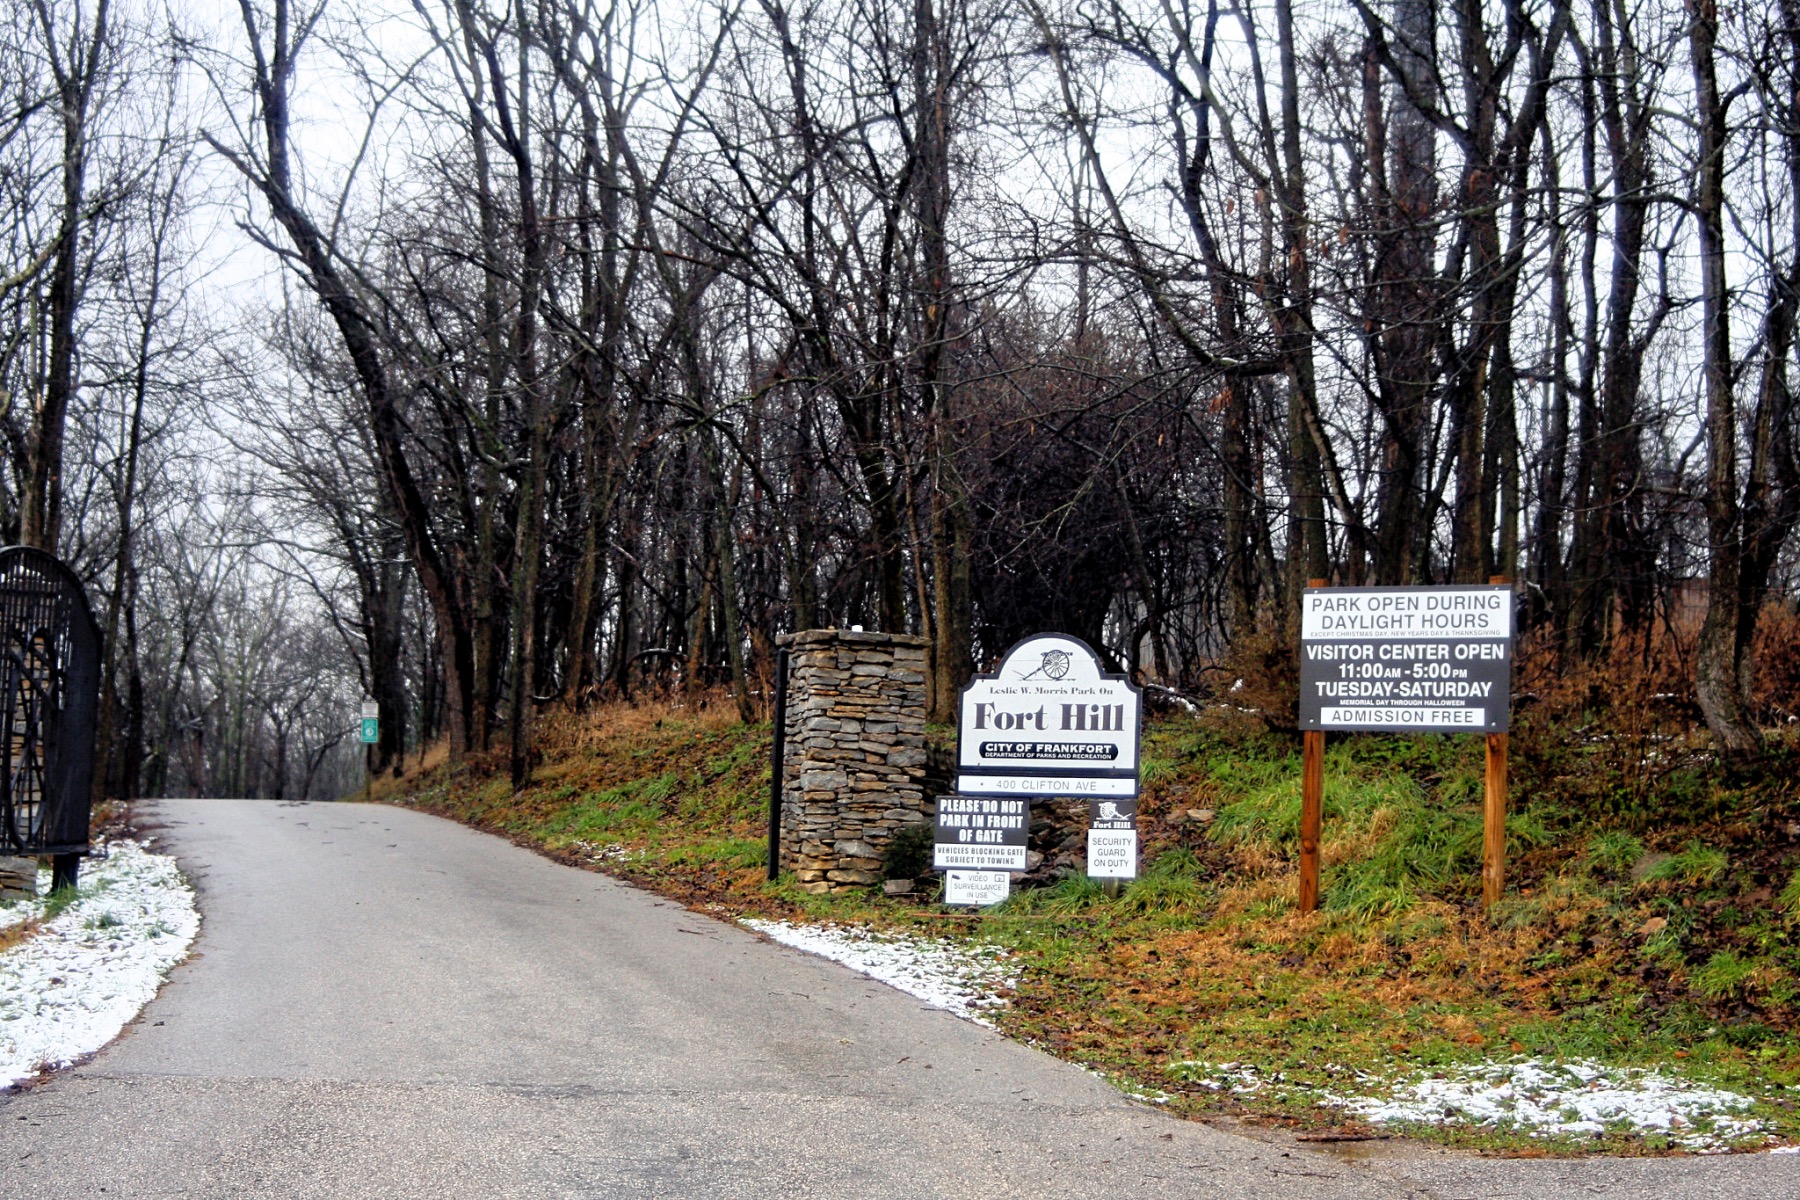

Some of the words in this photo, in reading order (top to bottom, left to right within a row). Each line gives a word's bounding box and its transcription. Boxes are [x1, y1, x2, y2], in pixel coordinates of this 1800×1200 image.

[1312, 598, 1361, 612] PARK
[1367, 596, 1419, 611] OPEN
[1427, 595, 1501, 611] DURING
[1322, 614, 1415, 630] DAYLIGHT
[1421, 613, 1489, 629] HOURS
[1306, 645, 1374, 660] VISITOR
[1379, 644, 1449, 660] CENTER
[1454, 644, 1504, 659] OPEN
[989, 687, 1018, 695] Leslie
[1021, 687, 1032, 695] W.
[1034, 687, 1068, 695] Morris
[1071, 687, 1096, 695] Park
[1099, 687, 1113, 695] On
[1315, 681, 1492, 697] TUESDAY-SATURDAY
[973, 701, 1049, 731] Fort
[1059, 703, 1125, 732] Hill
[1331, 710, 1424, 723] ADMISSION
[1431, 710, 1474, 723] FREE
[985, 743, 1013, 752] CITY
[1015, 743, 1032, 752] OF
[1036, 744, 1112, 753] FRANKFORT
[996, 780, 1016, 789] 400
[1021, 780, 1070, 791] CLIFTON
[1075, 781, 1097, 791] AVE
[939, 799, 980, 813] PLEASE
[982, 800, 997, 814] DO
[1001, 801, 1024, 814] NOT
[939, 814, 969, 827] PARK
[972, 814, 984, 828] IN
[987, 815, 1024, 829] FRONT
[1093, 821, 1111, 829] Fort
[1113, 821, 1131, 829] Hill
[958, 829, 973, 842] OF
[976, 829, 1003, 843] GATE
[1092, 837, 1132, 846] SECURITY
[937, 846, 969, 855] VEHICLES
[971, 847, 1005, 856] BLOCKING
[1007, 848, 1024, 856] GATE
[1097, 848, 1126, 857] GUARD
[945, 856, 974, 864] SUBJECT
[987, 857, 1015, 865] TOWING
[1093, 859, 1106, 867] ON
[1108, 859, 1129, 868] DUTY
[953, 883, 1002, 891] SURVEILLANCE
